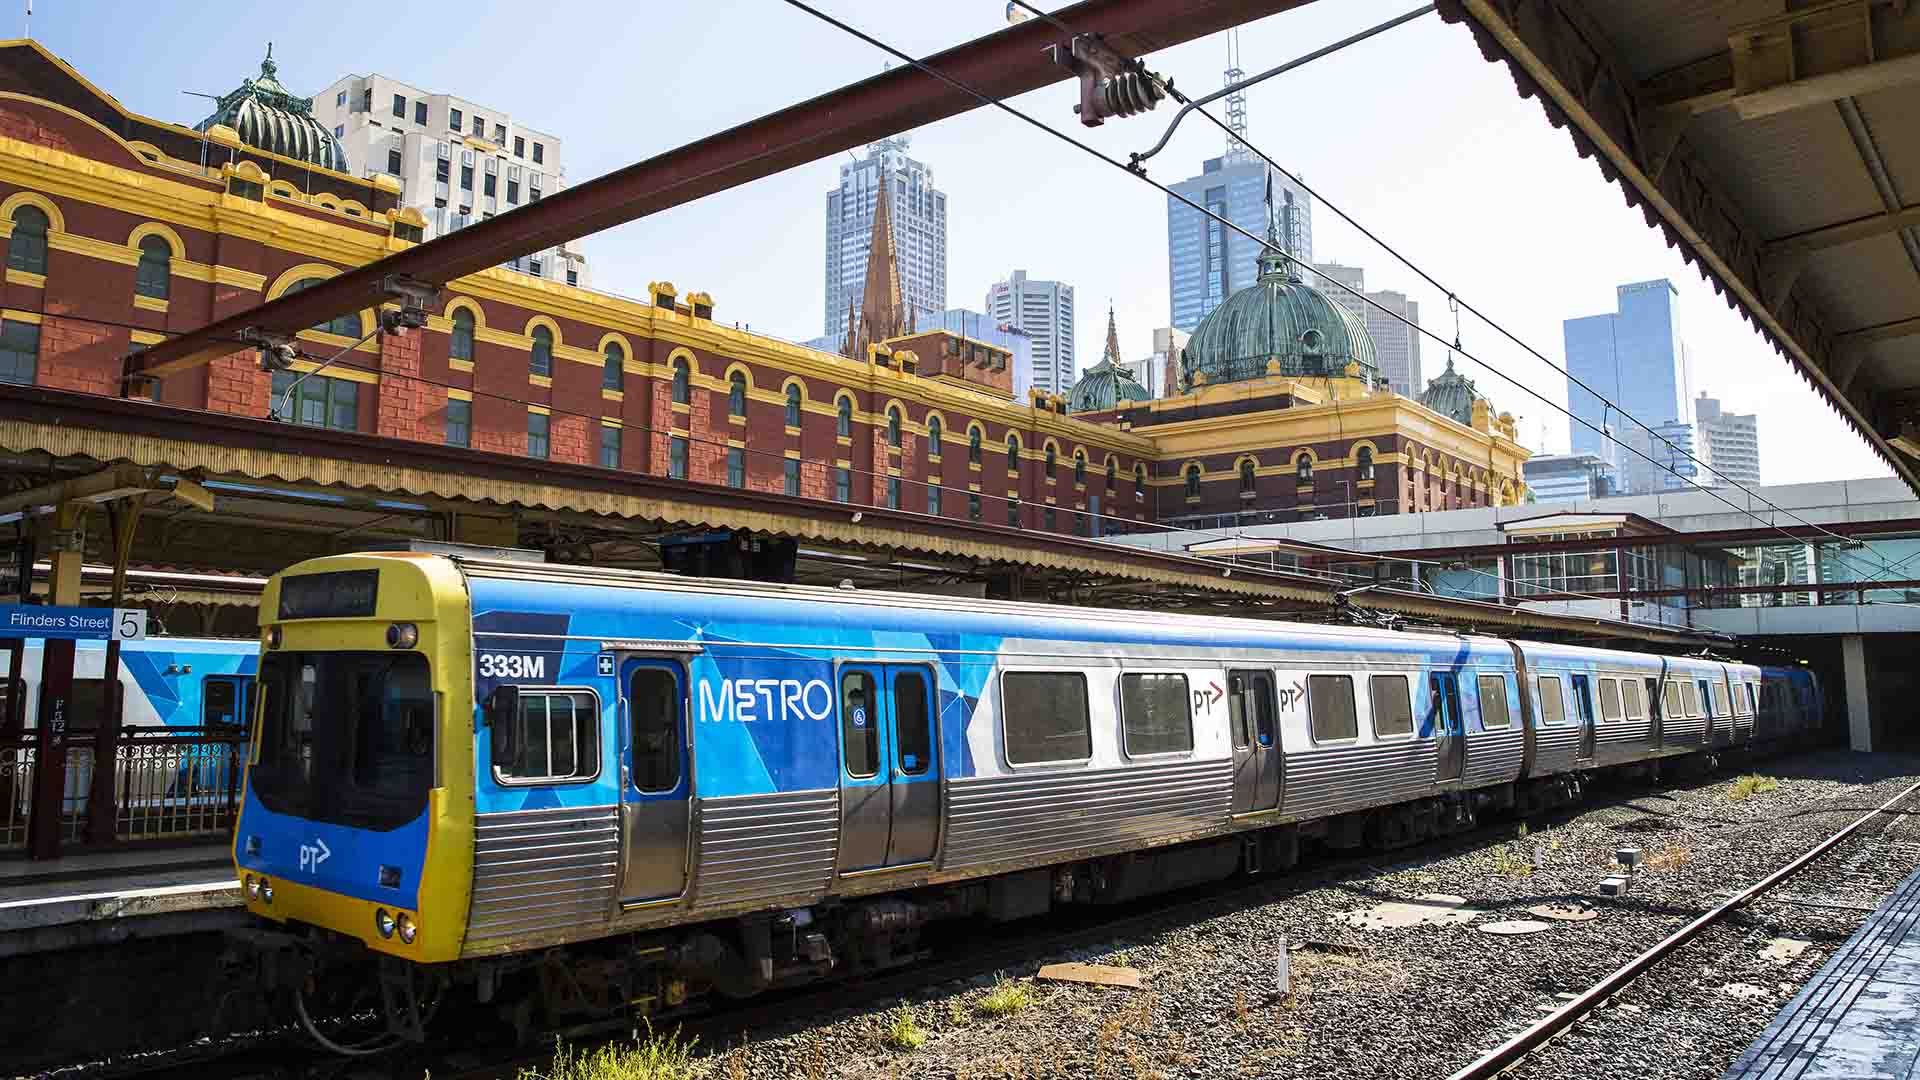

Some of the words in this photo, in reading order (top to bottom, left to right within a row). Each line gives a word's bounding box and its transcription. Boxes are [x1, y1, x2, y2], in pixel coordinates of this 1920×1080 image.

[10, 612, 66, 628] Flinders
[69, 615, 110, 629] Street
[119, 612, 139, 638] 5
[479, 653, 545, 679] 333M
[700, 679, 833, 722] METRO
